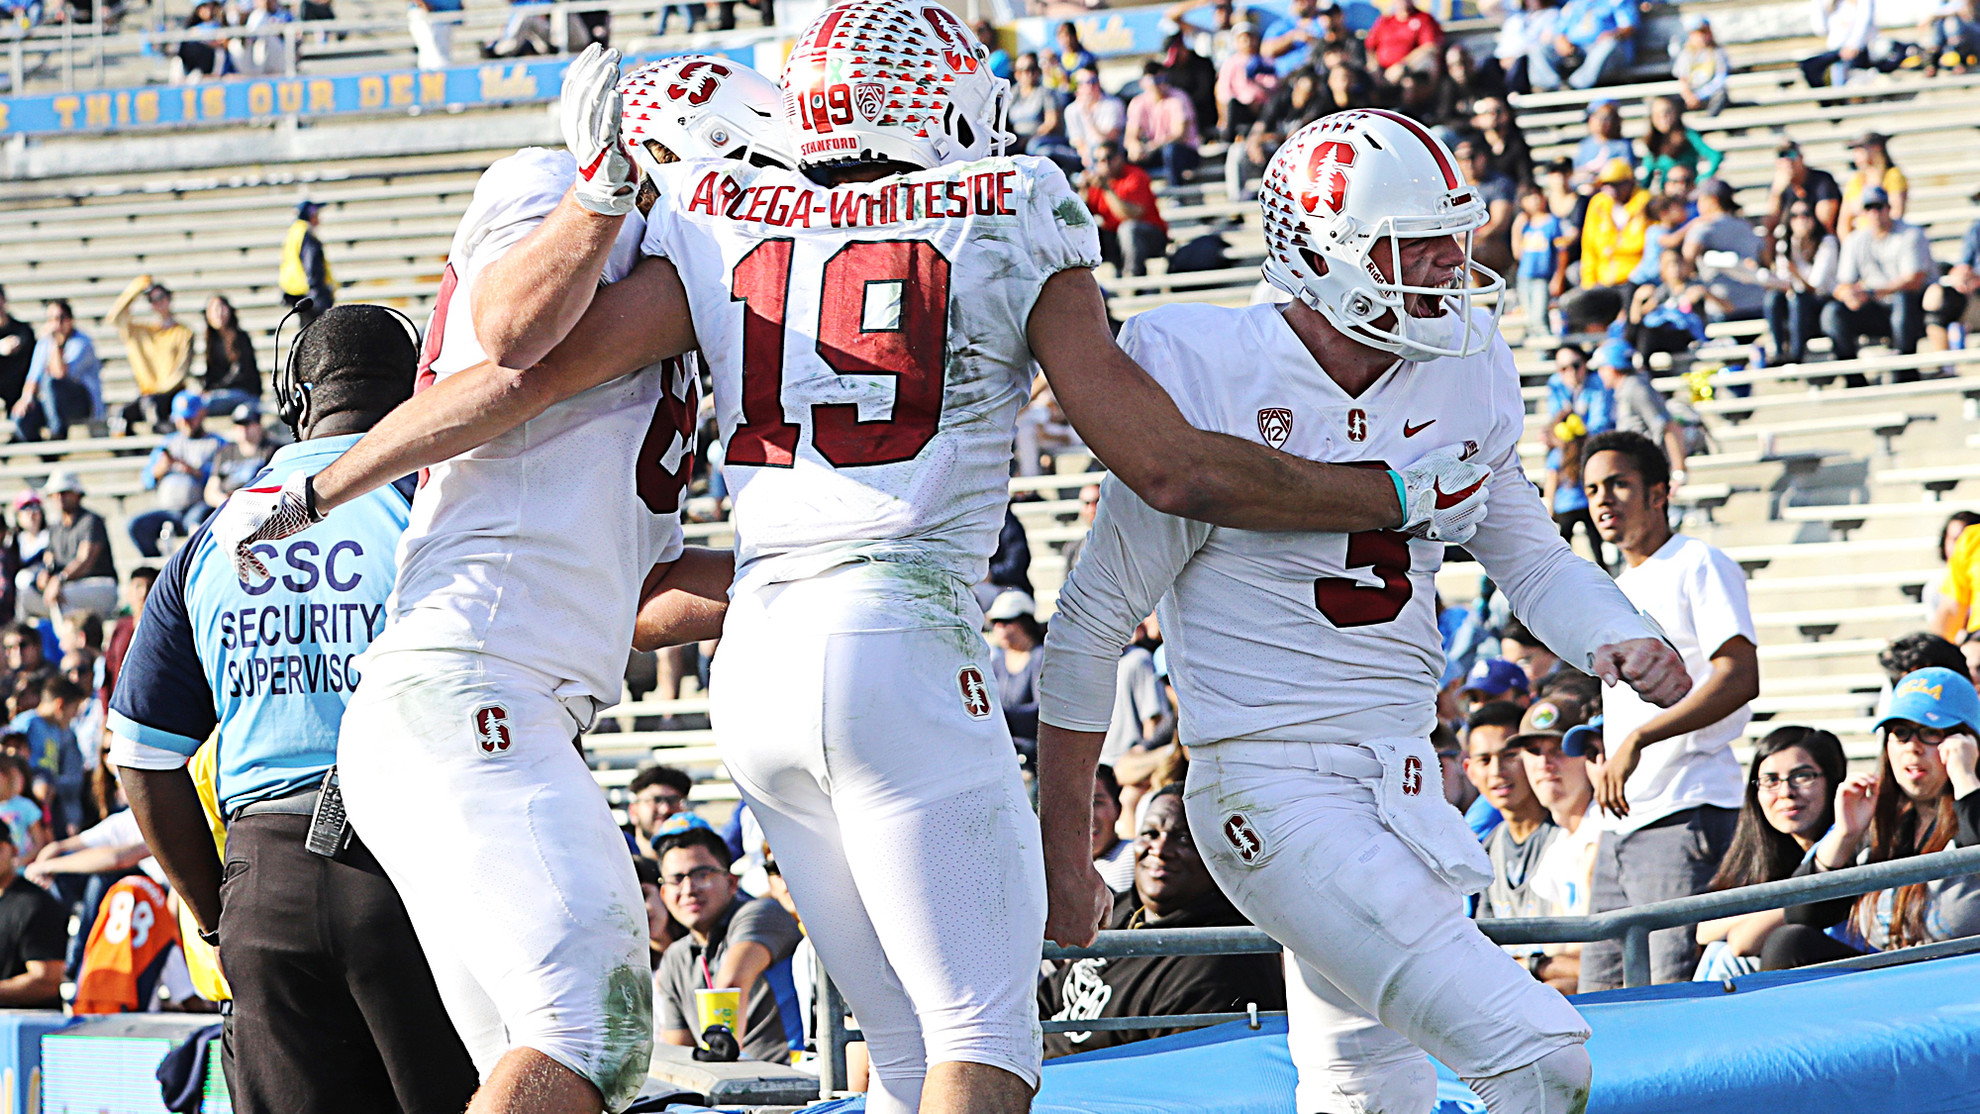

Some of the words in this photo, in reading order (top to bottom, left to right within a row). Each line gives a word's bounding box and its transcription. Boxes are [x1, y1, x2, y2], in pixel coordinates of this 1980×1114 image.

[53, 89, 159, 130] THIS
[181, 85, 226, 121] IS
[248, 79, 336, 115] OUR
[358, 72, 446, 109] DEN
[863, 102, 877, 114] 12
[800, 137, 858, 156] STANFORD
[688, 170, 1017, 229] ARCEGA-WHITESIDE
[1365, 261, 1392, 298] Riddll
[724, 236, 952, 469] 19
[1267, 426, 1284, 442] 12
[239, 540, 364, 596] CSC
[1313, 459, 1414, 629] 3
[221, 603, 383, 651] SECURITY
